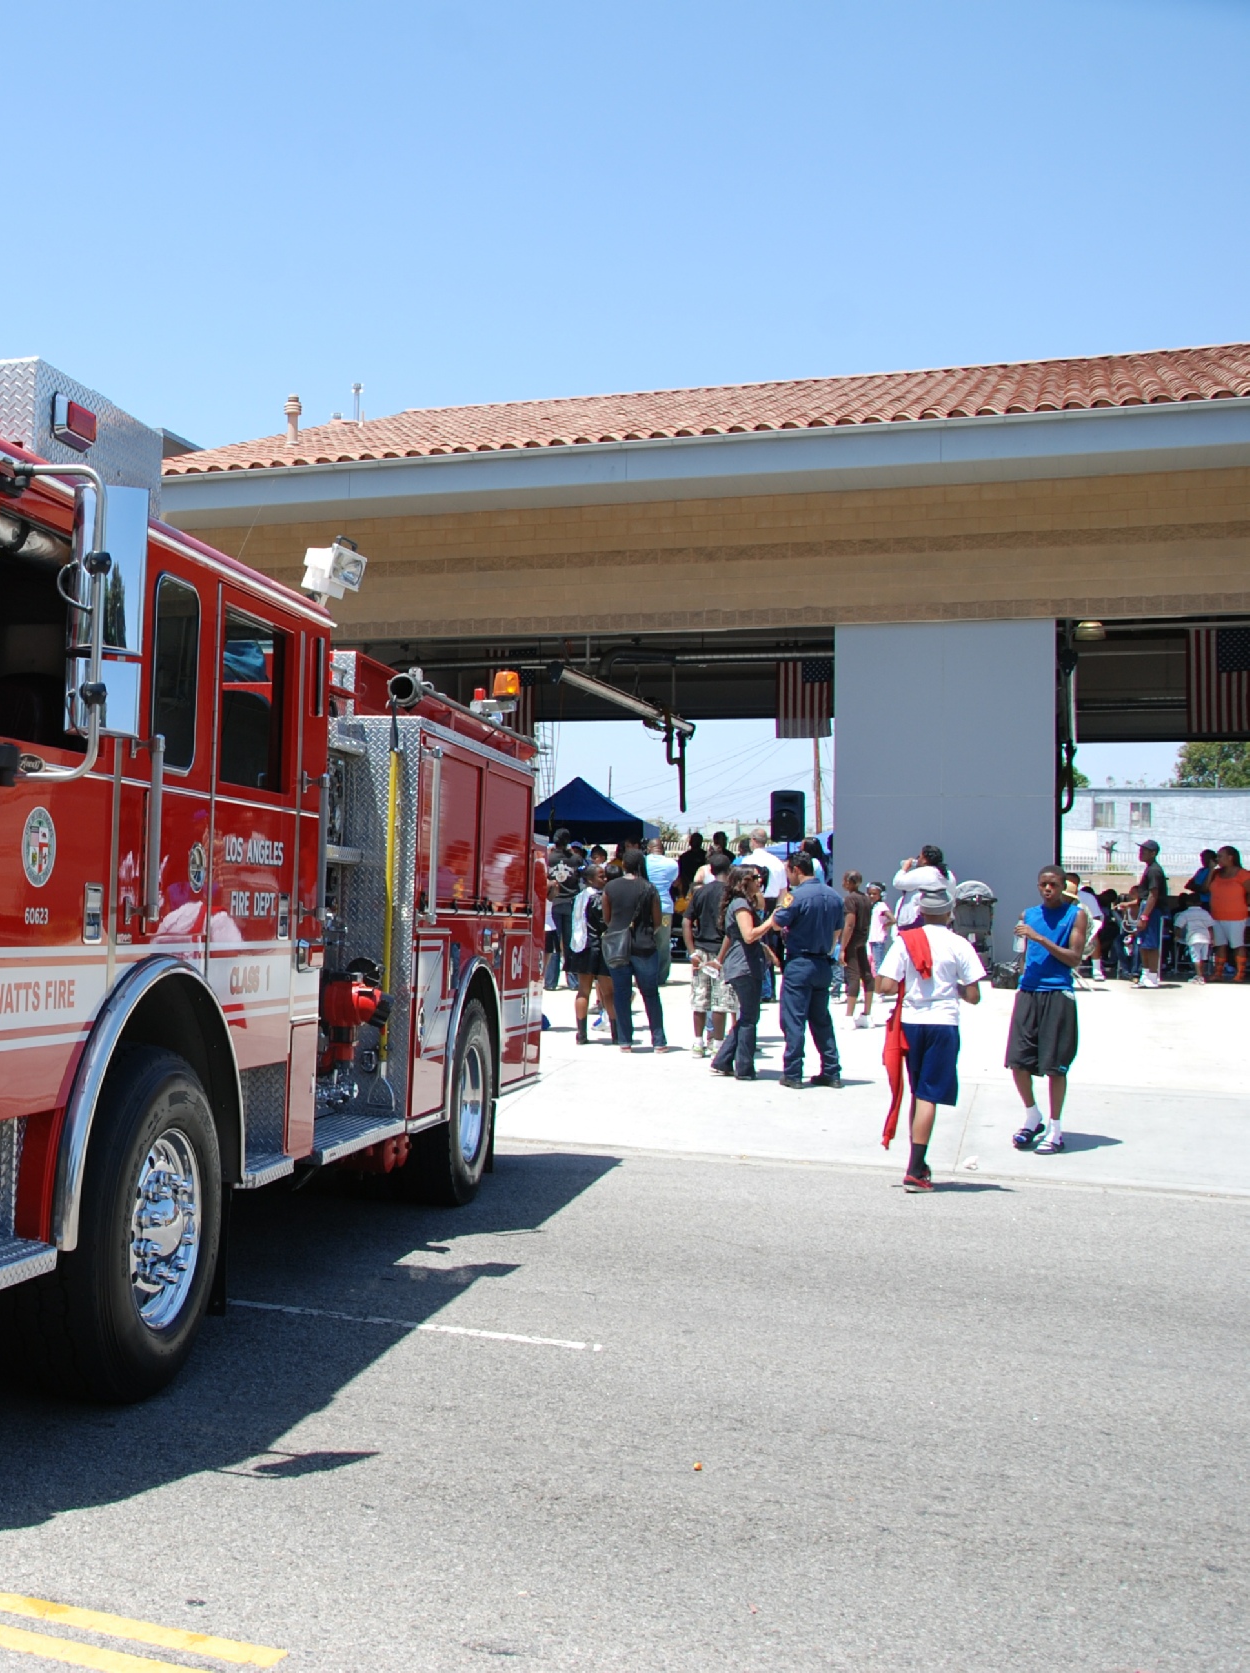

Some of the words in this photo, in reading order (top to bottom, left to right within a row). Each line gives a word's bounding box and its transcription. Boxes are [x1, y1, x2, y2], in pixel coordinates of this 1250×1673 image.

[225, 837, 244, 863] LOS
[247, 840, 284, 867] ANGELES
[24, 906, 49, 925] 60623
[230, 890, 249, 917] FIRE
[253, 891, 277, 917] DEPT.
[511, 945, 523, 980] 64
[45, 979, 75, 1011] FIRE
[230, 965, 261, 996] CLASS
